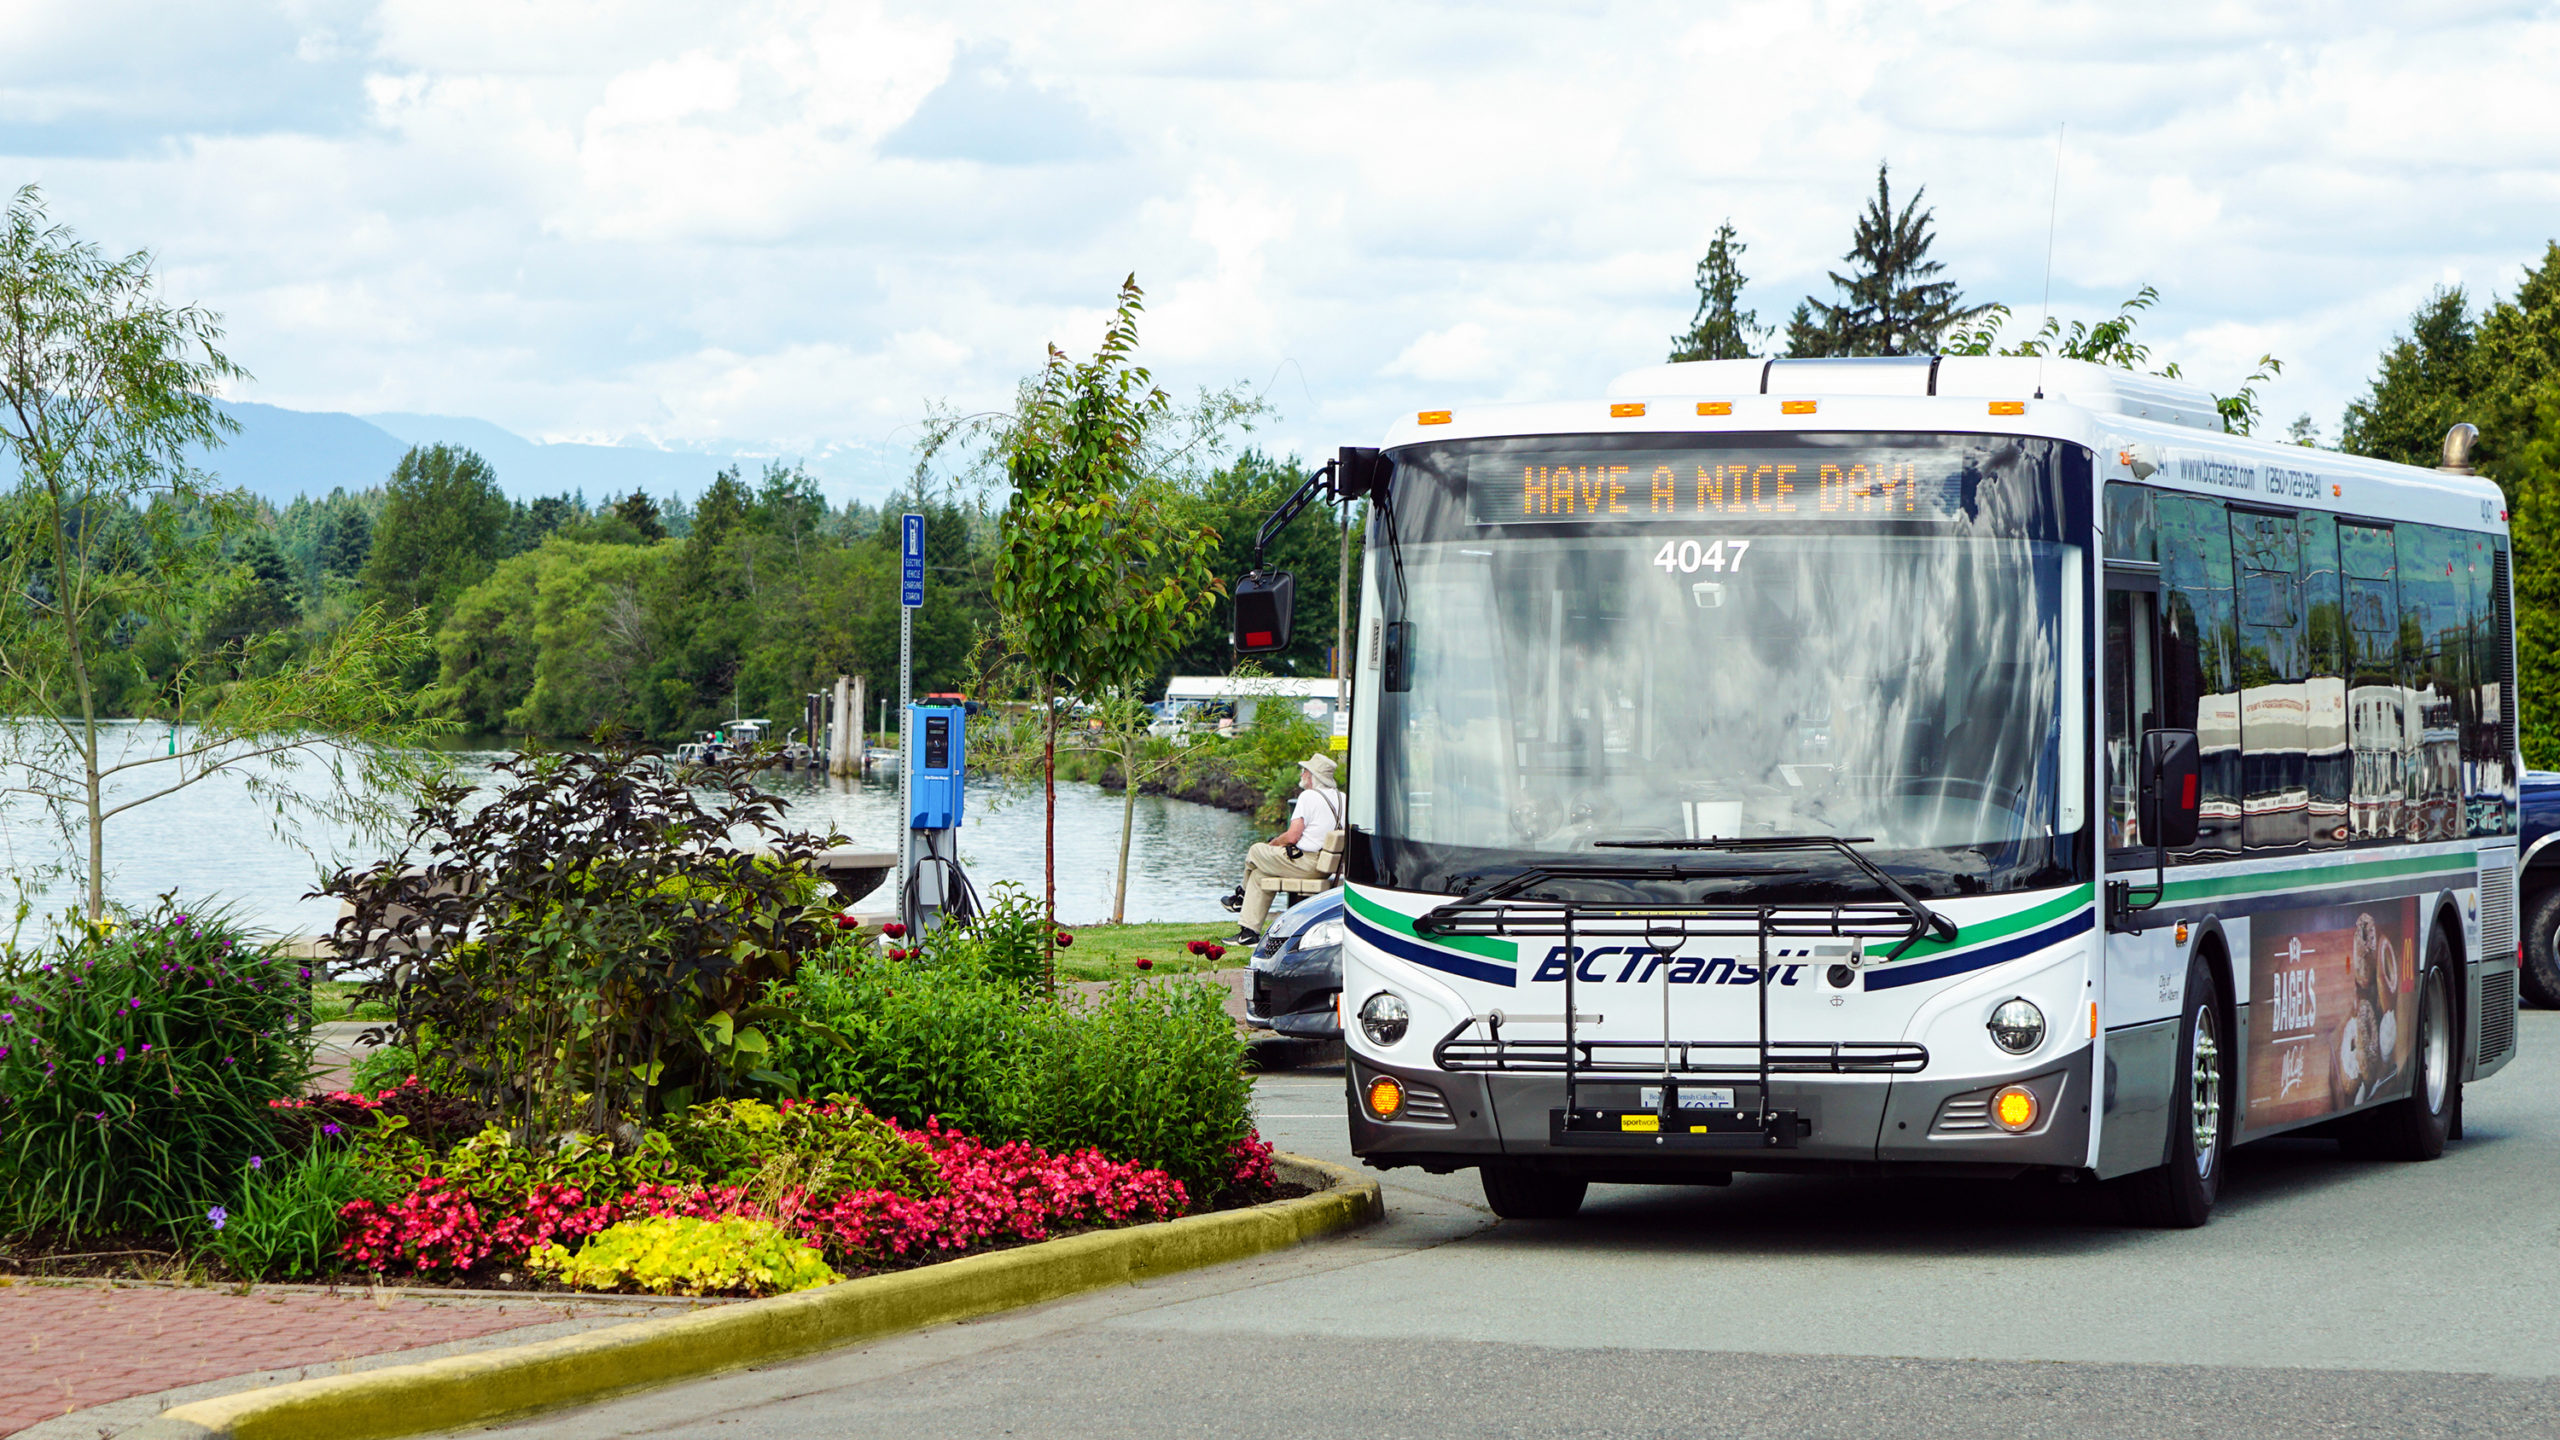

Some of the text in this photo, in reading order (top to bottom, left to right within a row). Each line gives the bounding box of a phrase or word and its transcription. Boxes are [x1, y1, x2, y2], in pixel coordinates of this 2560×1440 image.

[1524, 463, 1915, 514] HAVE A NICE DAY!
[1653, 540, 1750, 573] 4047
[2272, 968, 2317, 1033] BAGELS
